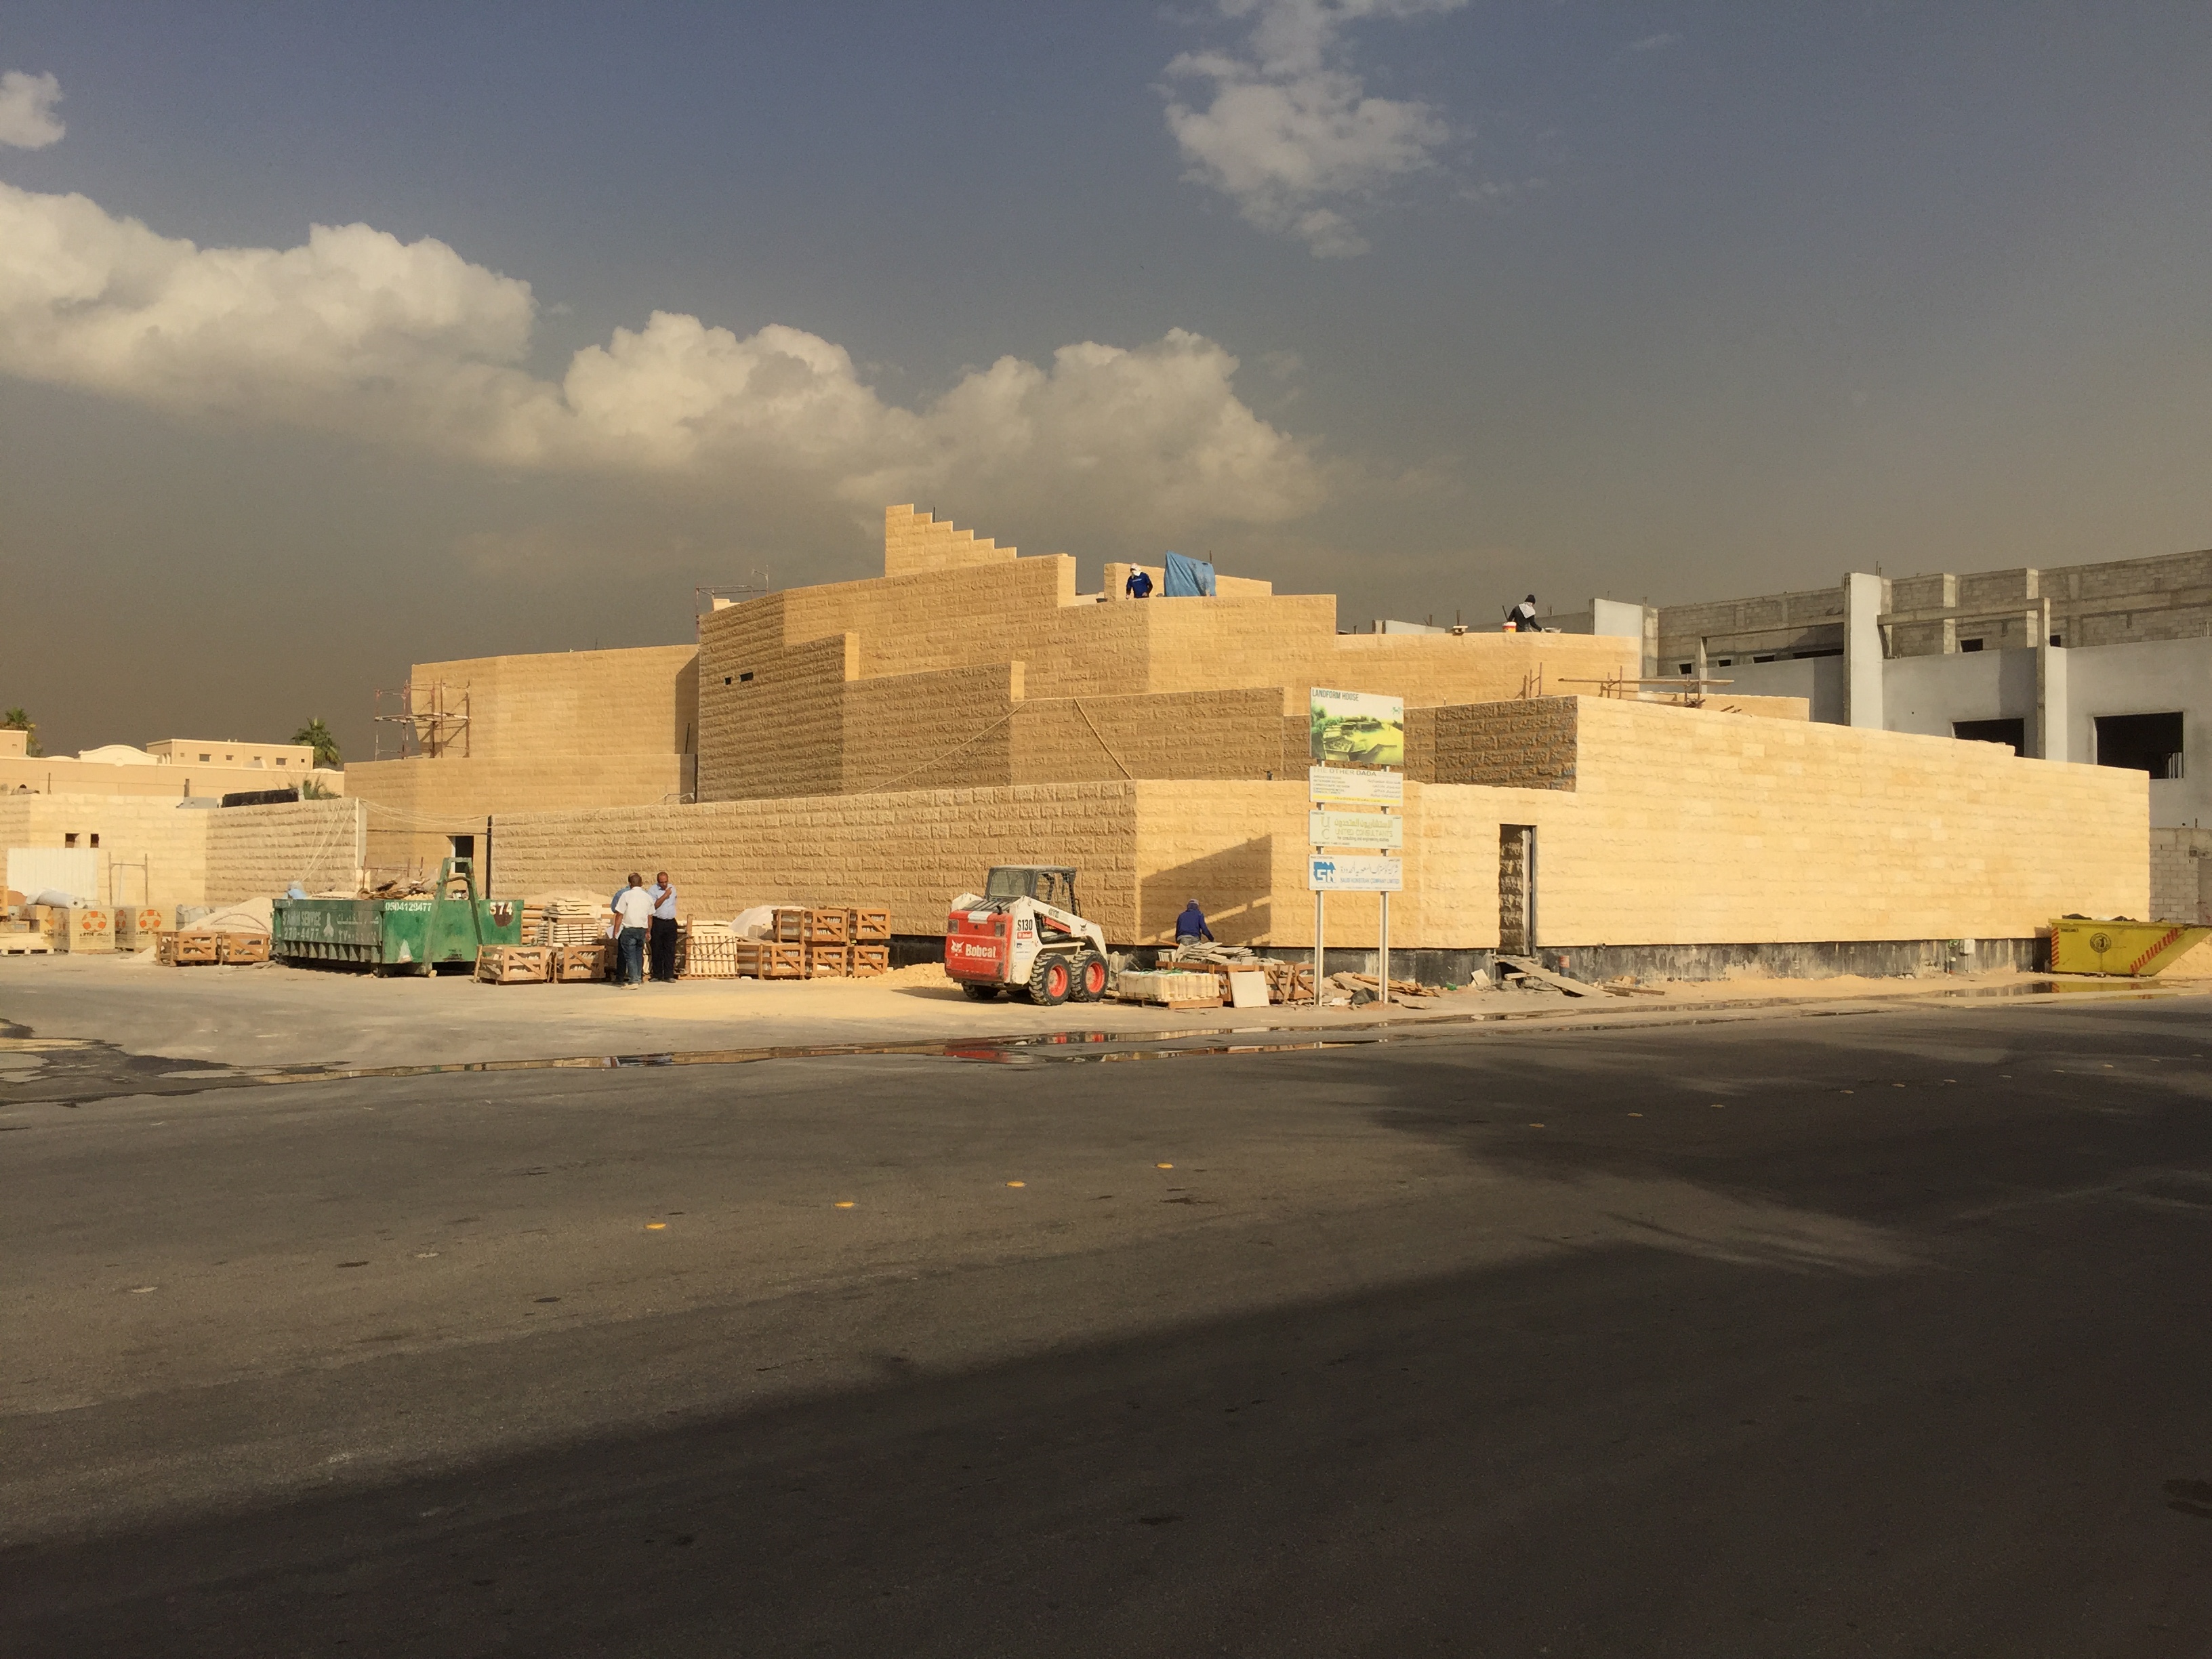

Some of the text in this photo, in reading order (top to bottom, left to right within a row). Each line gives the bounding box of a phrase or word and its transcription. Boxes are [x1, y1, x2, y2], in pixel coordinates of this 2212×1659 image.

[1312, 689, 1359, 701] LANDFORM HOUSE
[1355, 829, 1393, 838] CONSULTANTS
[385, 901, 432, 912] 0504129477
[489, 901, 513, 916] 574
[1017, 919, 1033, 931] S130
[965, 943, 997, 958] Bobcat
